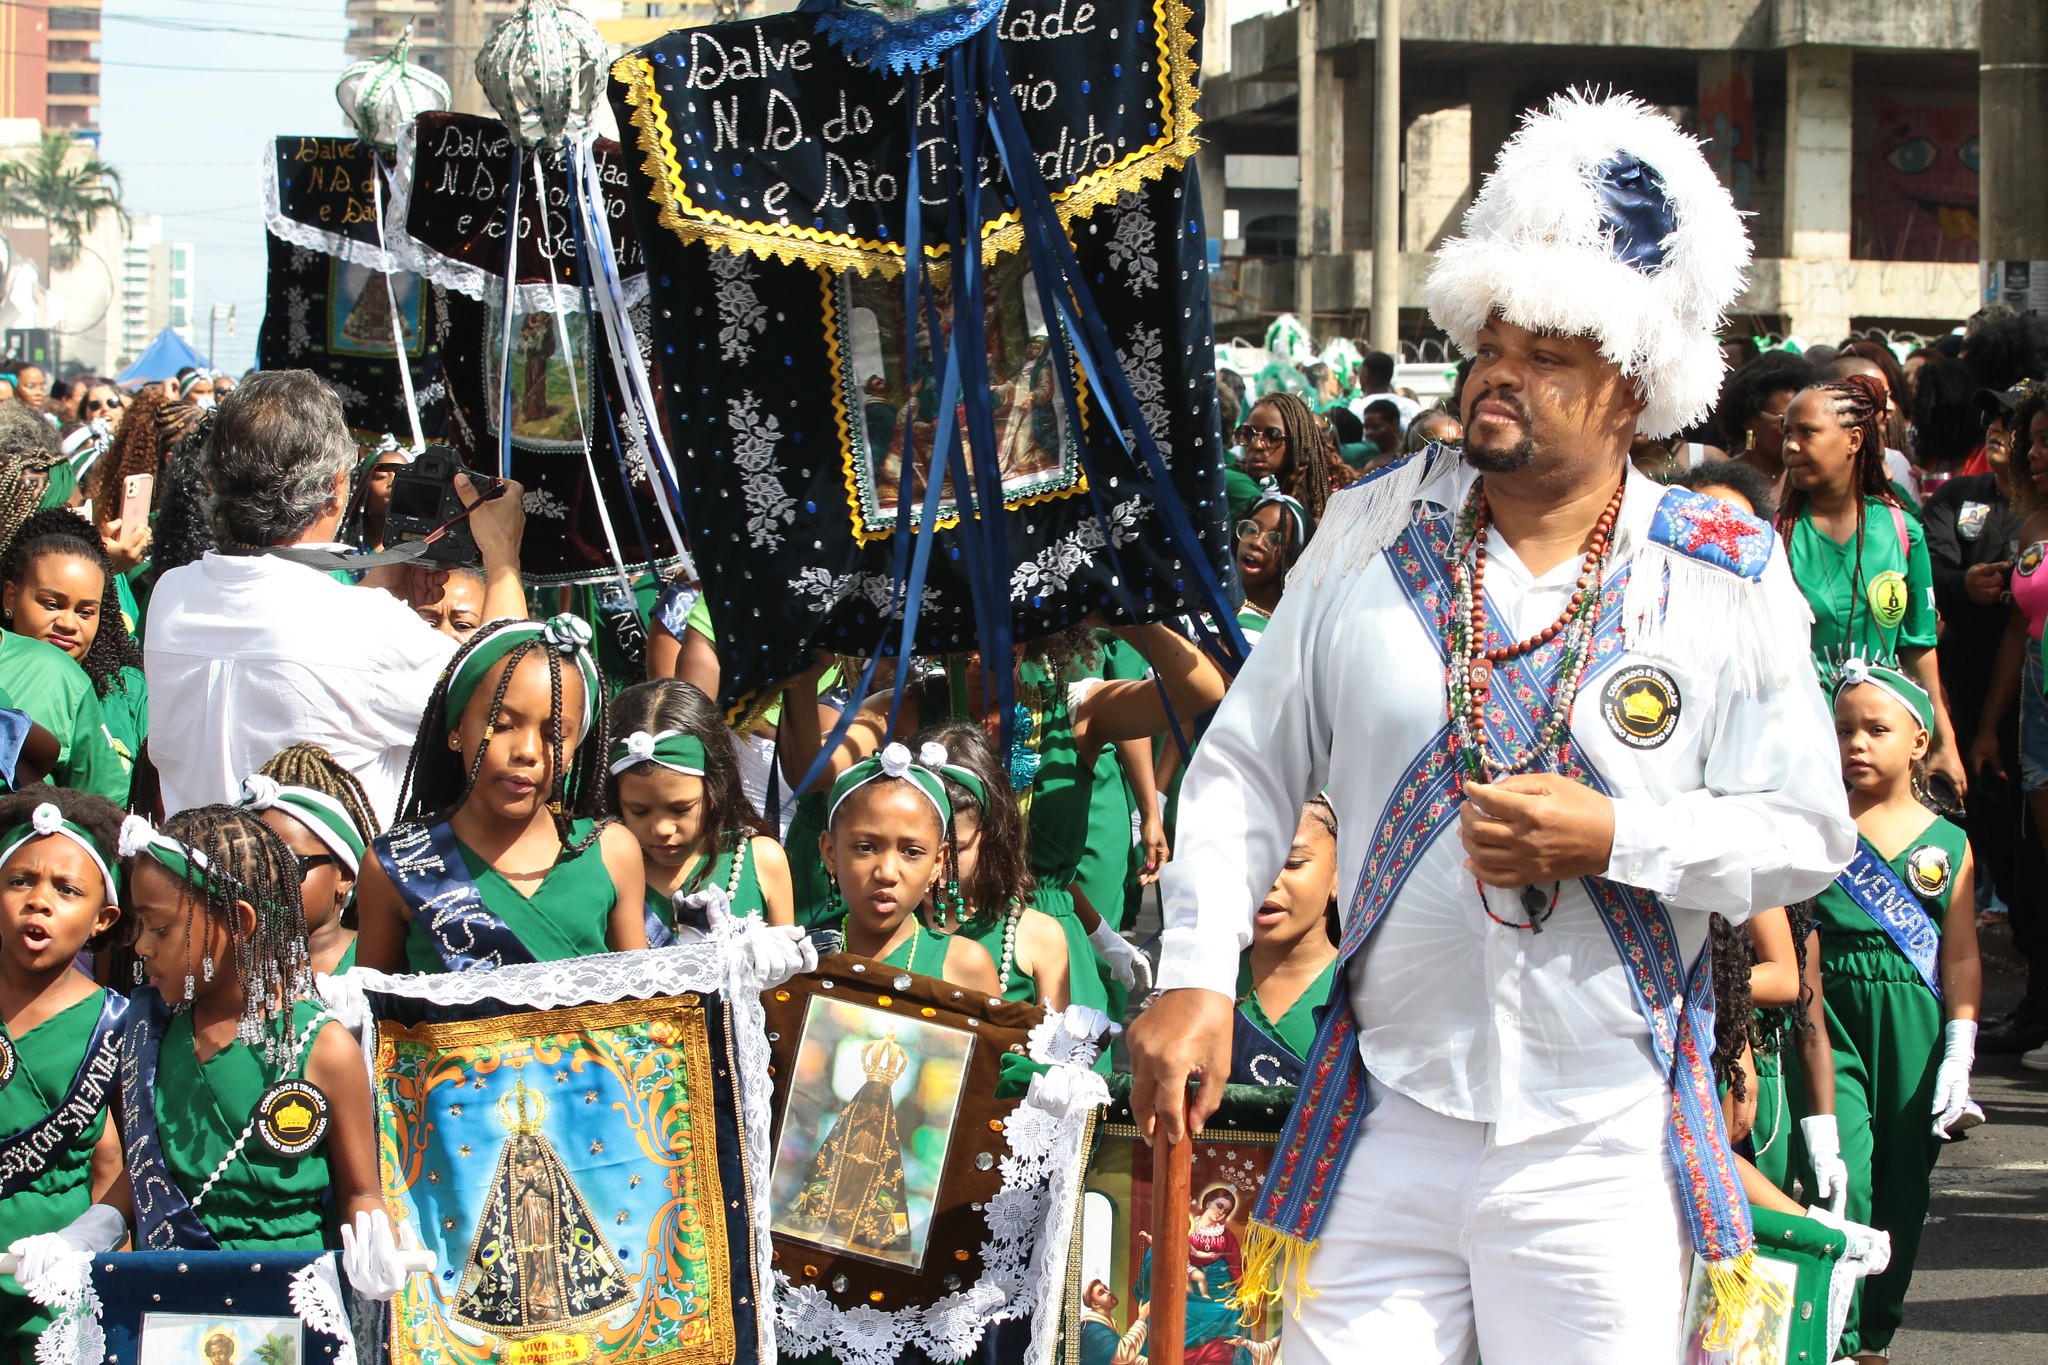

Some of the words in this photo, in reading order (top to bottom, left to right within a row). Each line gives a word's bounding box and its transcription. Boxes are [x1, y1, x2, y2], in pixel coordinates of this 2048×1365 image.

[763, 181, 790, 216] e
[1607, 669, 1645, 697] CONGADO
[1604, 703, 1627, 738] RACISMO
[260, 1083, 292, 1113] CONGADO
[299, 1083, 327, 1112] TRADIÇÃO
[258, 1119, 281, 1149] RACISMO
[280, 1135, 318, 1153] RELIGIOSO
[519, 1350, 579, 1365] APARECIDA
[522, 1342, 548, 1353] VIVA
